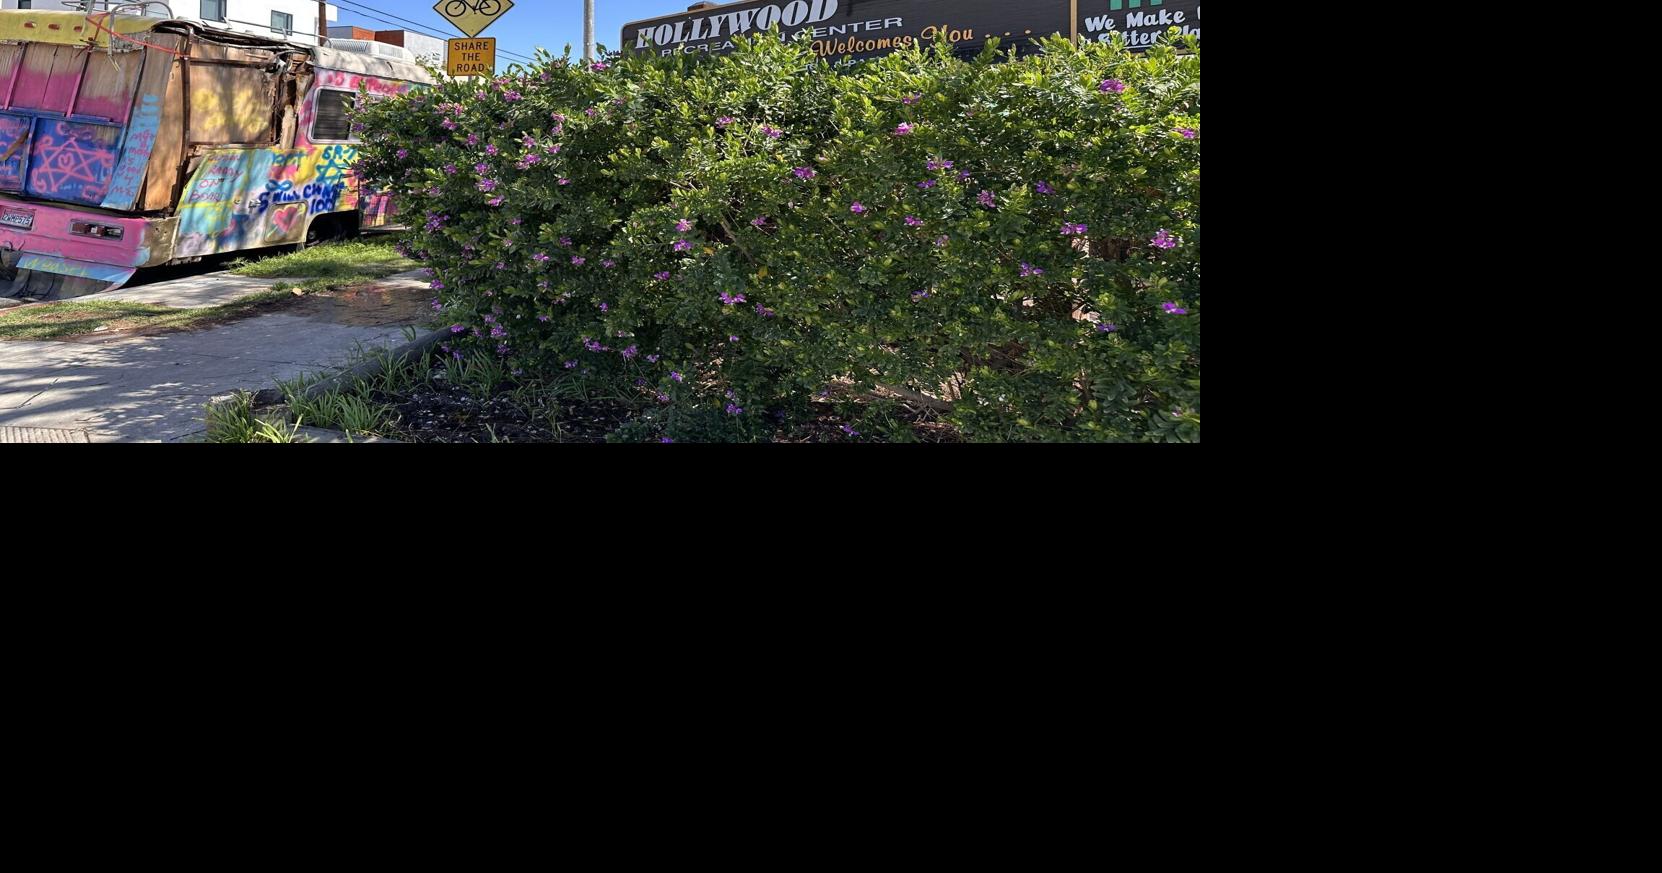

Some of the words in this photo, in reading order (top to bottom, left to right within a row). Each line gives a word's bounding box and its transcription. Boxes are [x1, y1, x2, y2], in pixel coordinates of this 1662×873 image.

[635, 0, 838, 49] HOLLYWOOD
[1085, 14, 1116, 32] We
[1126, 9, 1186, 28] Make
[454, 41, 489, 51] SHARE
[811, 35, 912, 57] Welcomes
[461, 52, 481, 61] THE
[456, 63, 485, 72] ROAD
